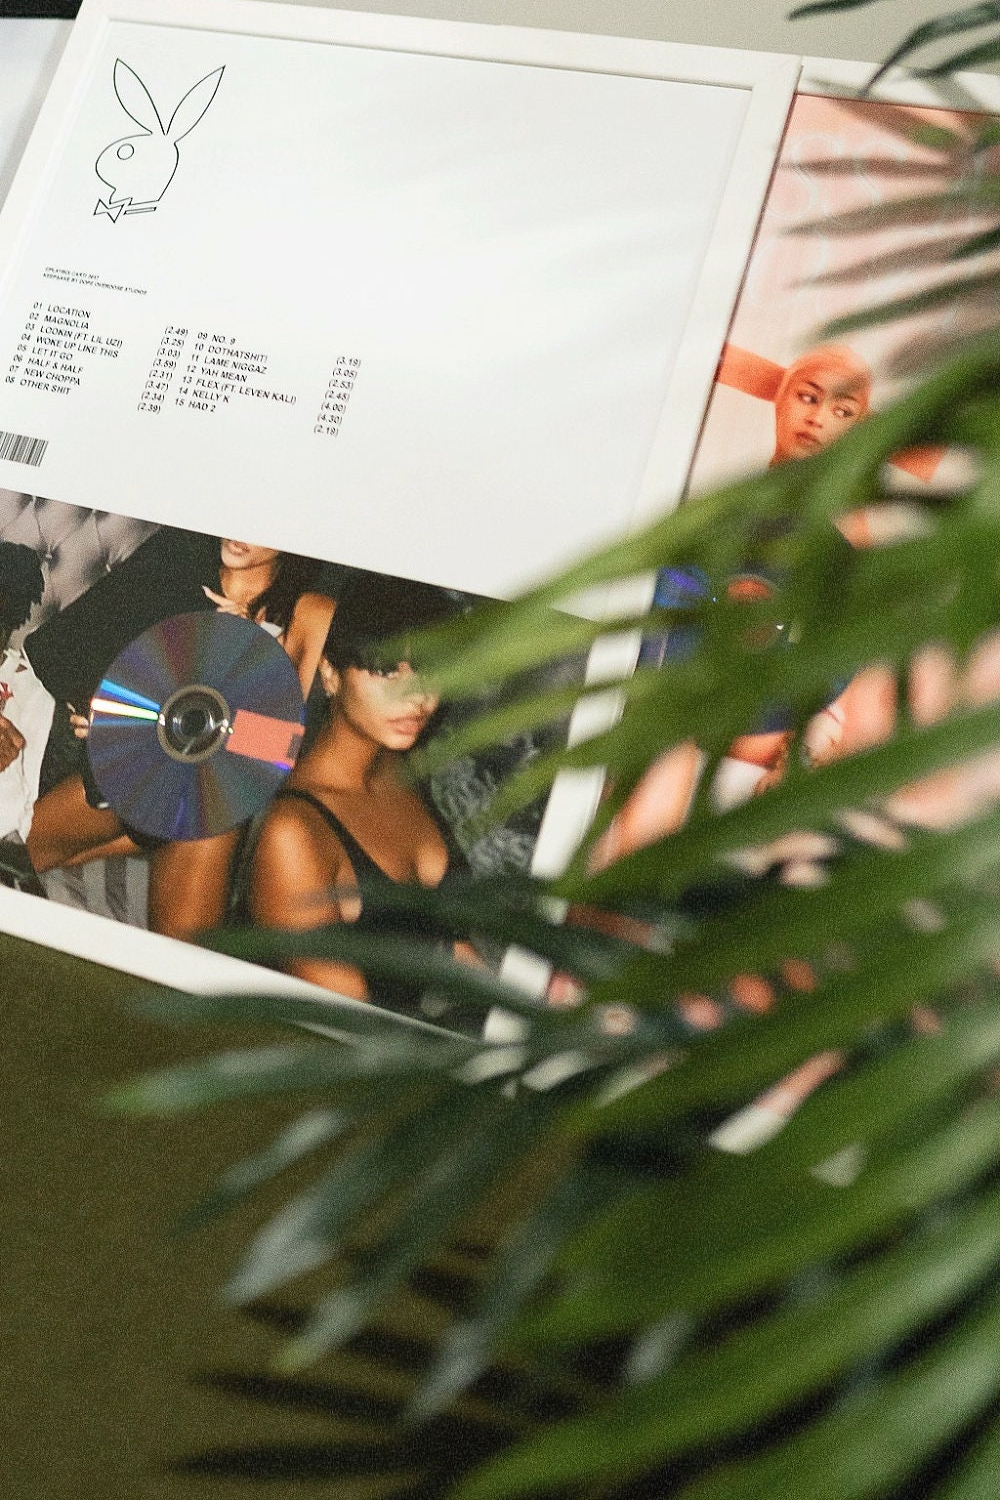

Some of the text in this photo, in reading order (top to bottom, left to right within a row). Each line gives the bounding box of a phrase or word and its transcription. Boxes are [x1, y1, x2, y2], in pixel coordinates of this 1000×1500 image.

[33, 301, 42, 309] 01
[48, 304, 91, 319] LOCATION
[29, 312, 39, 321] 02
[44, 314, 90, 329] MAGNOLIA
[25, 323, 35, 331] 03
[40, 325, 73, 338] LOOKIN
[91, 335, 104, 345] LIL
[197, 332, 208, 340] 09
[17, 344, 27, 352] 05
[32, 346, 48, 356] LET
[50, 348, 58, 357] IT
[59, 352, 73, 361] GO
[21, 333, 31, 341] 04
[36, 336, 62, 348] WOKE
[64, 341, 77, 349] UP
[77, 343, 100, 354] LIKE
[100, 347, 119, 358] THIS
[194, 343, 204, 351] 10
[13, 354, 23, 363] 06
[28, 357, 51, 368] HALF
[52, 361, 58, 370] &
[60, 363, 84, 374] HALF
[191, 354, 199, 362] 11
[204, 356, 230, 367] LAME
[232, 361, 268, 375] NIGGAZ
[9, 365, 19, 373] 07
[24, 368, 45, 379] NEW
[45, 372, 81, 386] CHOPPA
[186, 365, 196, 373] 12
[201, 367, 219, 378] YAH
[220, 371, 247, 383] MEAN
[20, 378, 50, 391] OTHER
[51, 383, 72, 395] SHIT
[179, 386, 189, 395] 14
[192, 389, 221, 401] KELLY
[223, 395, 230, 404] K
[182, 376, 192, 384] 13
[196, 378, 220, 390] FLEX
[239, 386, 270, 399] LEVEN
[271, 392, 297, 406] KALI)
[175, 398, 185, 406] 15
[188, 400, 208, 411] HAD
[210, 404, 217, 413] 2
